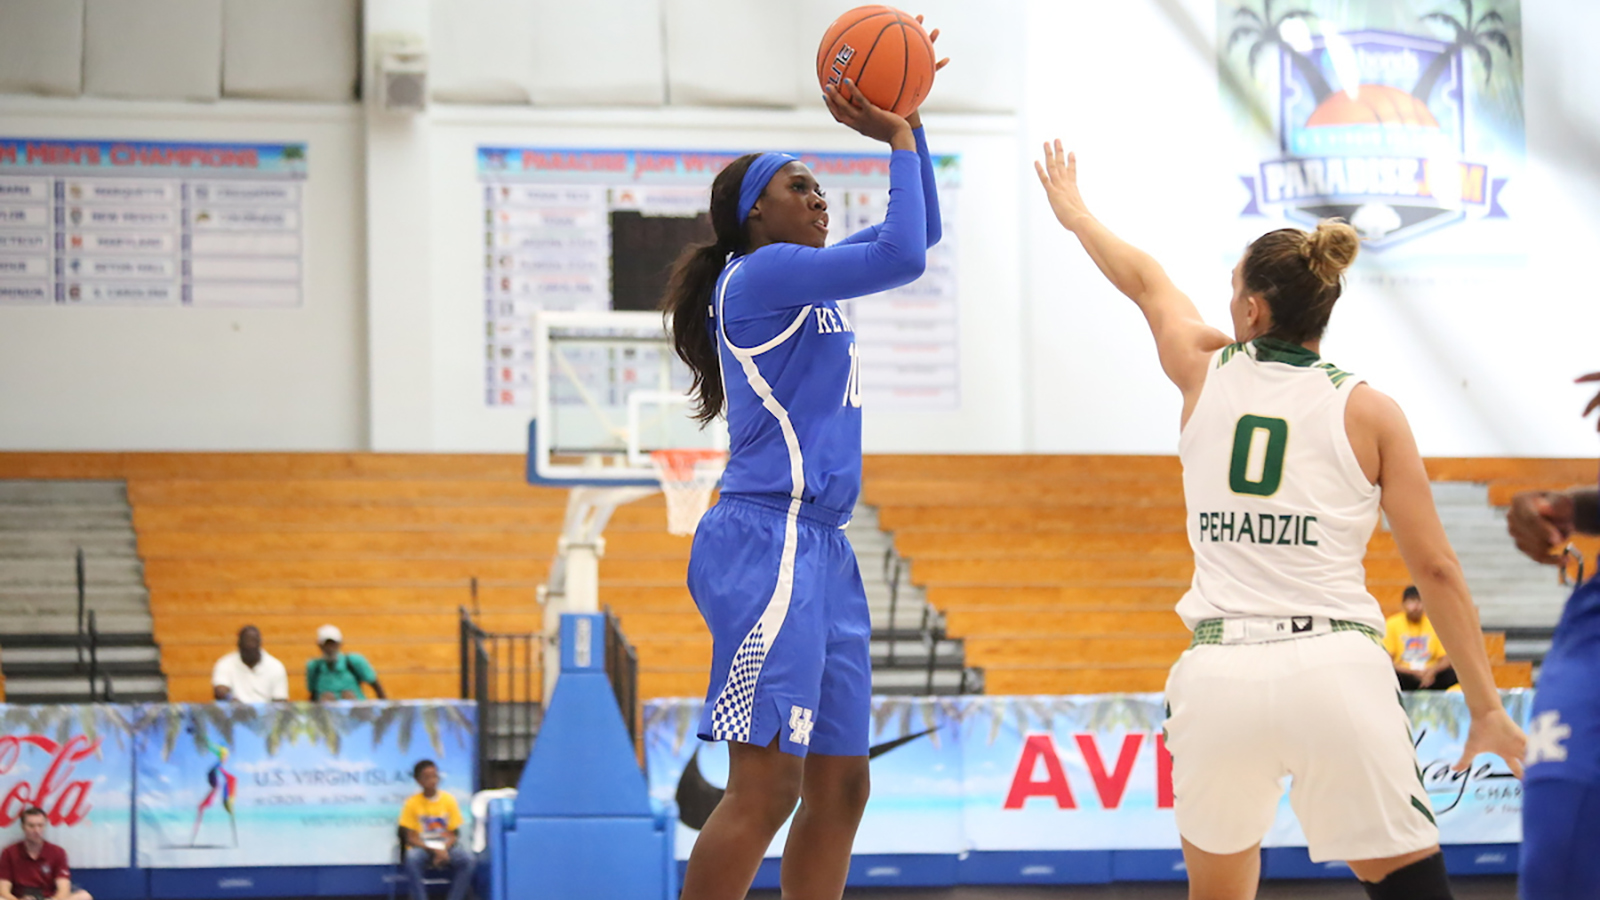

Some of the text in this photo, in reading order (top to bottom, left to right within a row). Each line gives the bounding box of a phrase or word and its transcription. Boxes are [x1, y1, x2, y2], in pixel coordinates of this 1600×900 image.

[827, 43, 856, 86] LITE
[109, 145, 259, 168] CHAMPIONS
[522, 151, 627, 172] PARADISE
[633, 153, 677, 180] JAM
[1263, 157, 1488, 204] PARADISE JM
[814, 306, 856, 335] KEN
[1228, 413, 1289, 498] 0
[1199, 511, 1319, 547] PEHADZIC
[788, 704, 814, 747] UK
[0, 734, 105, 828] ola
[292, 768, 360, 786] VIRGIN
[365, 768, 415, 786] ISLA
[1003, 733, 1175, 810] AVI
[1474, 785, 1523, 801] CHAR
